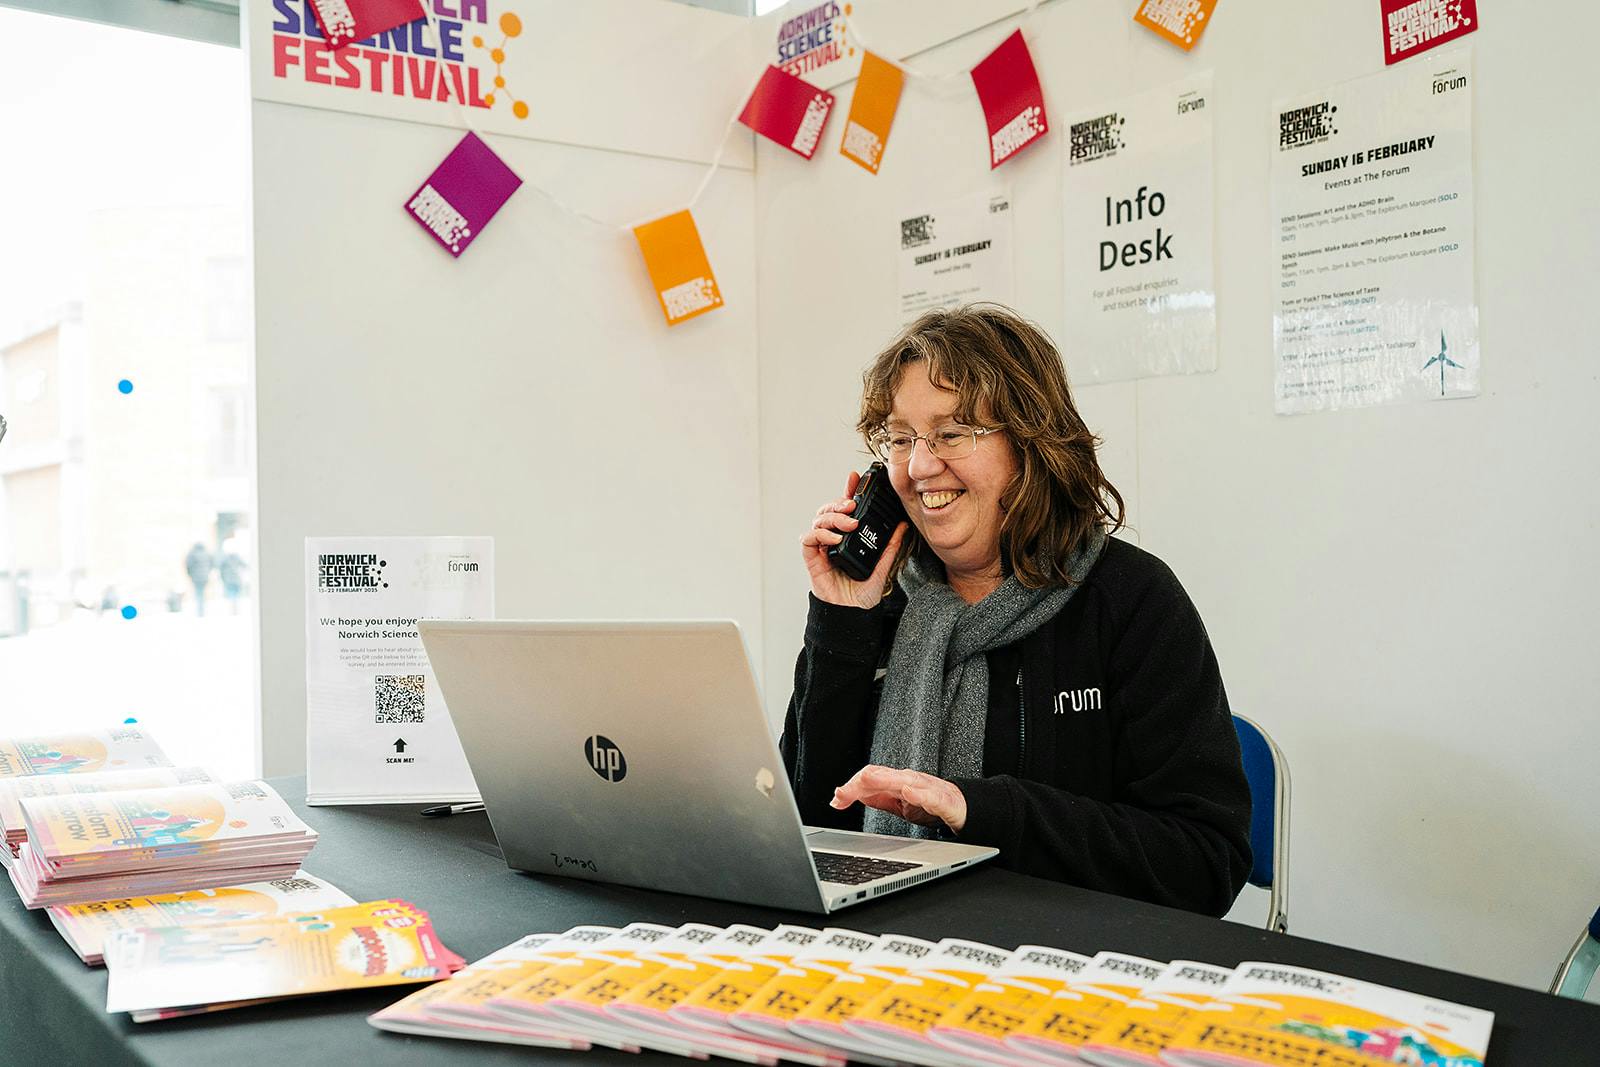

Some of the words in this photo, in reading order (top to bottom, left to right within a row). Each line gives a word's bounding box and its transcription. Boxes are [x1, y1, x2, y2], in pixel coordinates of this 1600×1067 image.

[778, 23, 832, 63] SCIENCE
[1390, 15, 1459, 55] FESTIVAL
[273, 34, 491, 109] FESTIVAL
[1432, 76, 1467, 95] forum
[1177, 97, 1205, 115] forum
[1280, 101, 1329, 124] NORWICH
[1070, 113, 1117, 136] NORWICH
[1280, 114, 1322, 136] SCIENCE
[1070, 127, 1111, 148] SCIENCE
[1280, 125, 1330, 146] FESTIVAL
[1070, 138, 1117, 160] FESTIVAL
[1302, 156, 1348, 177] SUNDAY
[1352, 152, 1364, 166] 16
[1367, 135, 1436, 162] FEBRUARY
[1324, 177, 1352, 190] Events
[1353, 176, 1362, 185] at
[1364, 172, 1379, 183] The
[1381, 166, 1411, 180] Forum
[1106, 186, 1165, 227] Info
[1324, 207, 1334, 215] Art
[1334, 204, 1346, 213] and
[1347, 202, 1357, 210] the
[1358, 199, 1377, 208] ADHD
[1377, 195, 1395, 204] Brain
[1409, 197, 1437, 209] Marquee
[953, 239, 992, 257] FEBRUARY
[1324, 244, 1341, 253] Make
[1342, 240, 1359, 250] Music
[1360, 237, 1375, 246] with
[1409, 229, 1421, 237] the
[1422, 225, 1447, 236] Botano
[1100, 228, 1174, 272] Desk
[1409, 247, 1437, 258] Marquee
[1438, 243, 1459, 253] (SOLD
[1093, 289, 1105, 298] For
[1116, 282, 1143, 295] Festival
[1144, 277, 1179, 291] enquiries
[1321, 293, 1332, 301] The
[1333, 290, 1355, 300] Science
[1356, 288, 1363, 296] of
[1363, 286, 1380, 295] Taste
[862, 525, 878, 544] link
[318, 554, 377, 565] NORWICH
[448, 560, 479, 572] forum
[318, 566, 370, 577] SCIENCE
[318, 576, 379, 588] FESTIVAL
[320, 618, 336, 626] We
[338, 617, 363, 627] hope
[365, 618, 383, 627] you
[386, 617, 422, 627] enjoye
[338, 630, 380, 639] Norwich
[382, 630, 419, 639] Science
[590, 735, 621, 782] hp
